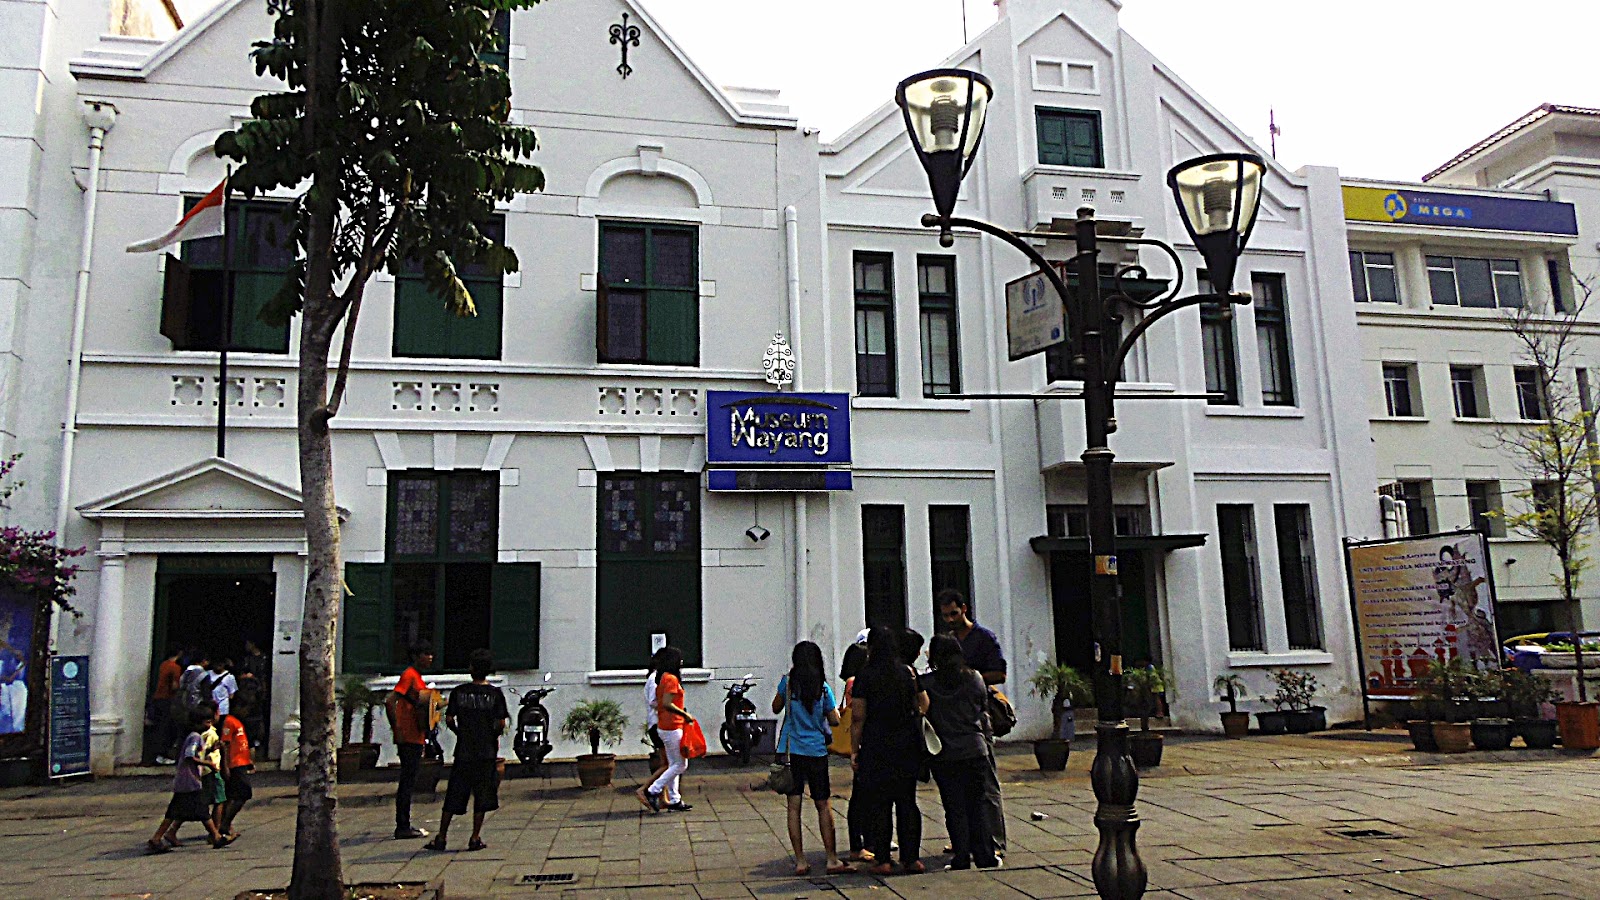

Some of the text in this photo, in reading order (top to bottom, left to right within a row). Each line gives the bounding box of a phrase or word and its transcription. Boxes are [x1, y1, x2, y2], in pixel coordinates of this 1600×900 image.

[1418, 205, 1465, 217] MEGA
[731, 406, 829, 429] Museum
[731, 426, 829, 455] Wayang
